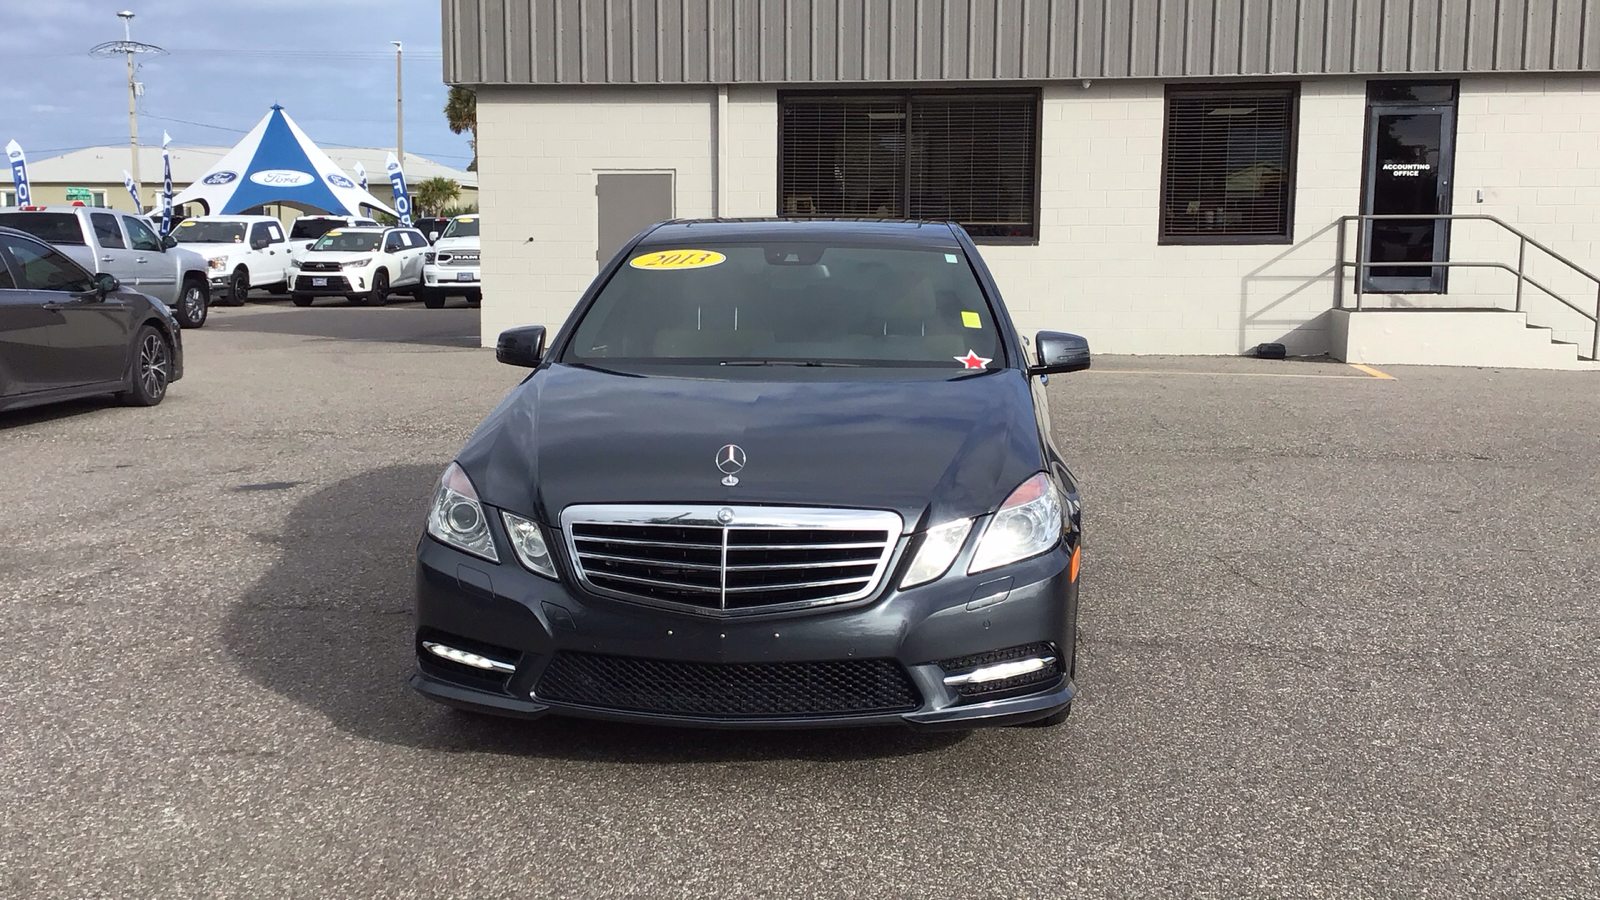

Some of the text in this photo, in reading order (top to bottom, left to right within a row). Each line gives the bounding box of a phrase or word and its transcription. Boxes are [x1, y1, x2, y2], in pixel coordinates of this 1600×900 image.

[206, 171, 232, 184] Ford
[263, 172, 300, 184] Ford
[645, 253, 711, 266] 2013
